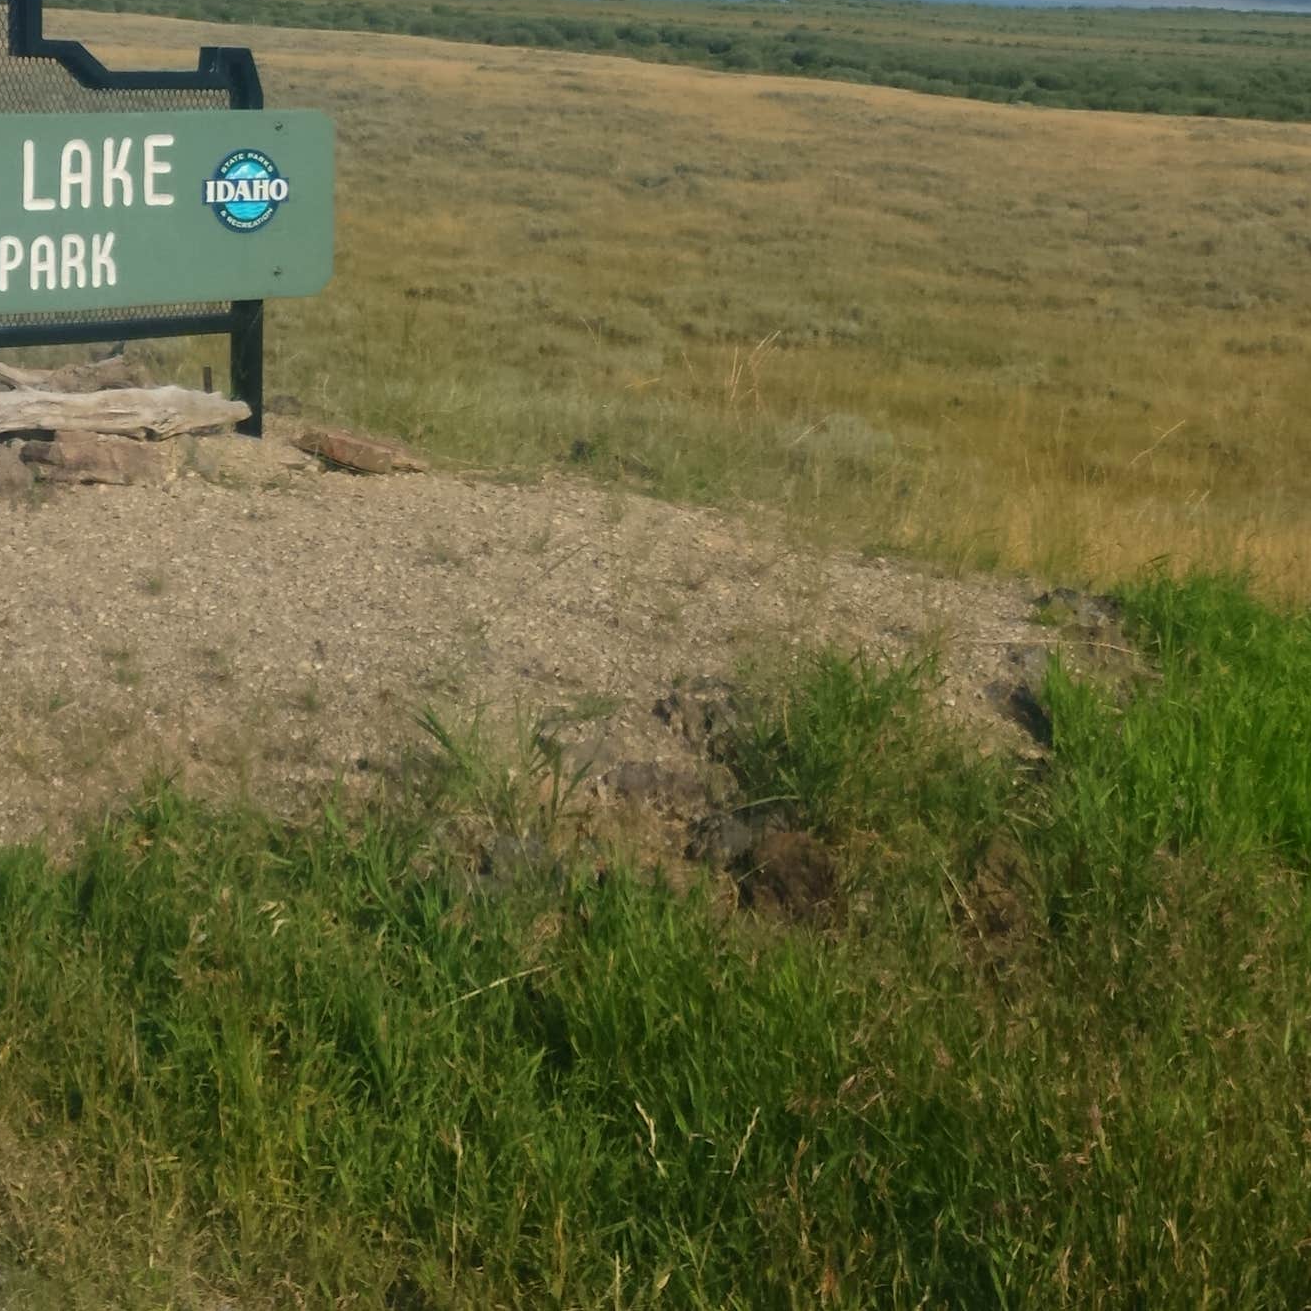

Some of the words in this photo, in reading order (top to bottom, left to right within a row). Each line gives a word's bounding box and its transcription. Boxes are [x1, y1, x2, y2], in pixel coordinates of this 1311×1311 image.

[23, 134, 175, 211] LAKE
[221, 153, 244, 174] STATE
[247, 152, 274, 173] PARKS
[205, 178, 288, 203] IDAHO
